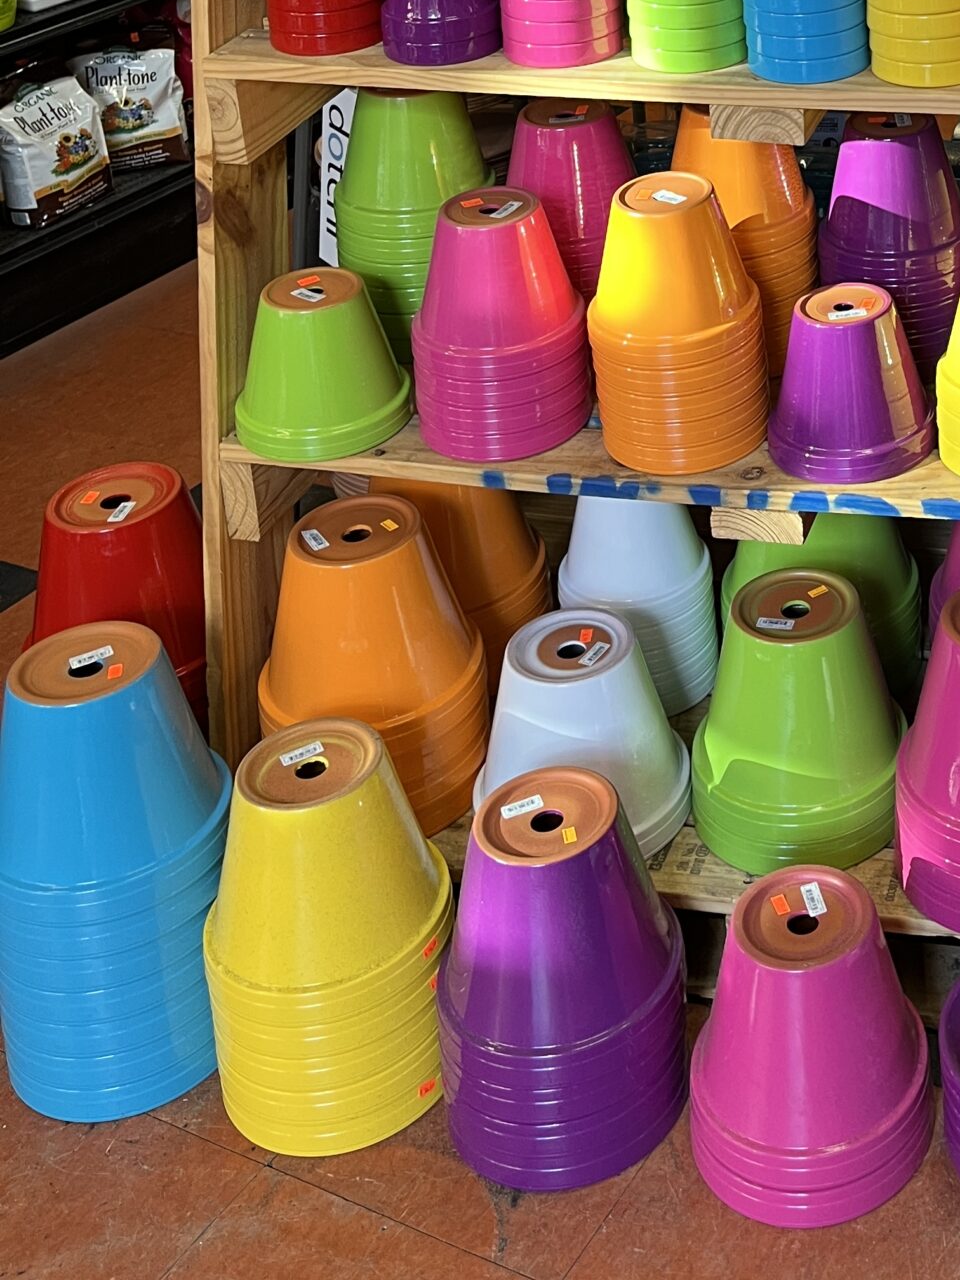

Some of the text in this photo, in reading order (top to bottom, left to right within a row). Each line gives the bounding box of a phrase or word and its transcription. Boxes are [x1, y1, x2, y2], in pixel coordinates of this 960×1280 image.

[94, 53, 147, 65] ORGANIC
[84, 65, 158, 89] Plant-tone
[14, 87, 58, 114] ORGANIC
